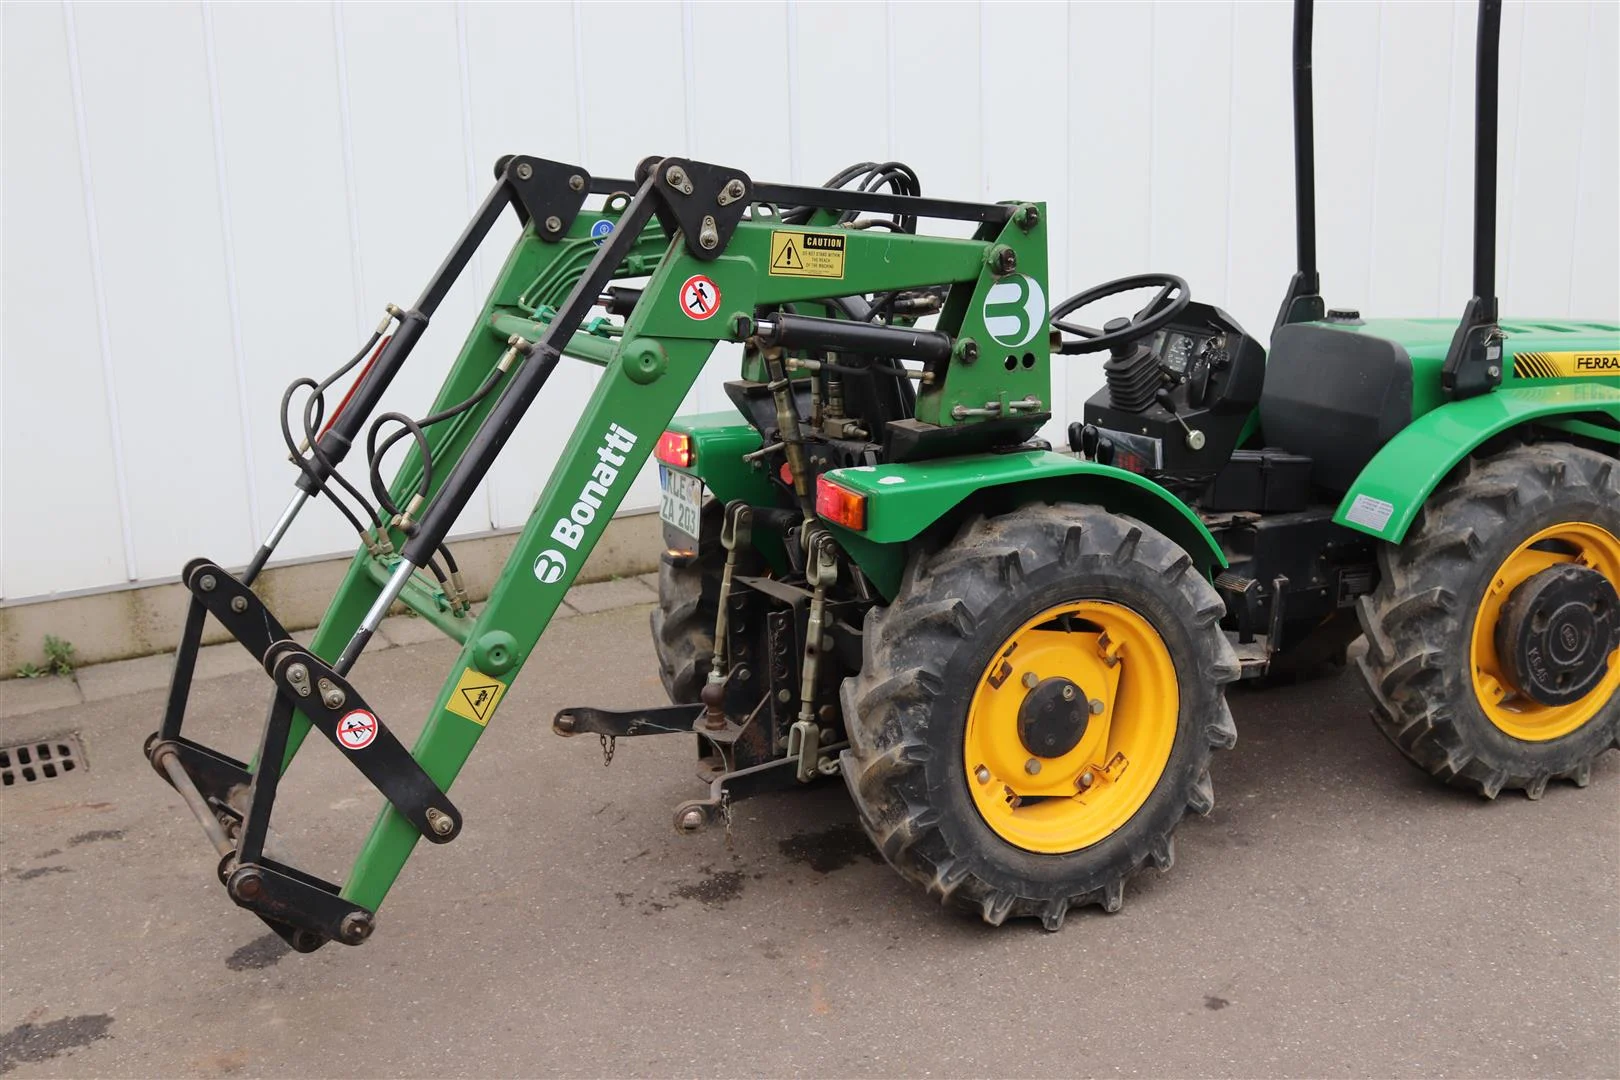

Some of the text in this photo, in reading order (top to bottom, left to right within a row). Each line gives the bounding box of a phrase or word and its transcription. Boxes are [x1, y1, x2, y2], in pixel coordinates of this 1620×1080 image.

[807, 236, 842, 248] CAUTION
[550, 422, 638, 550] Bonatti
[667, 468, 686, 501] KLE
[662, 494, 696, 534] ZA 203
